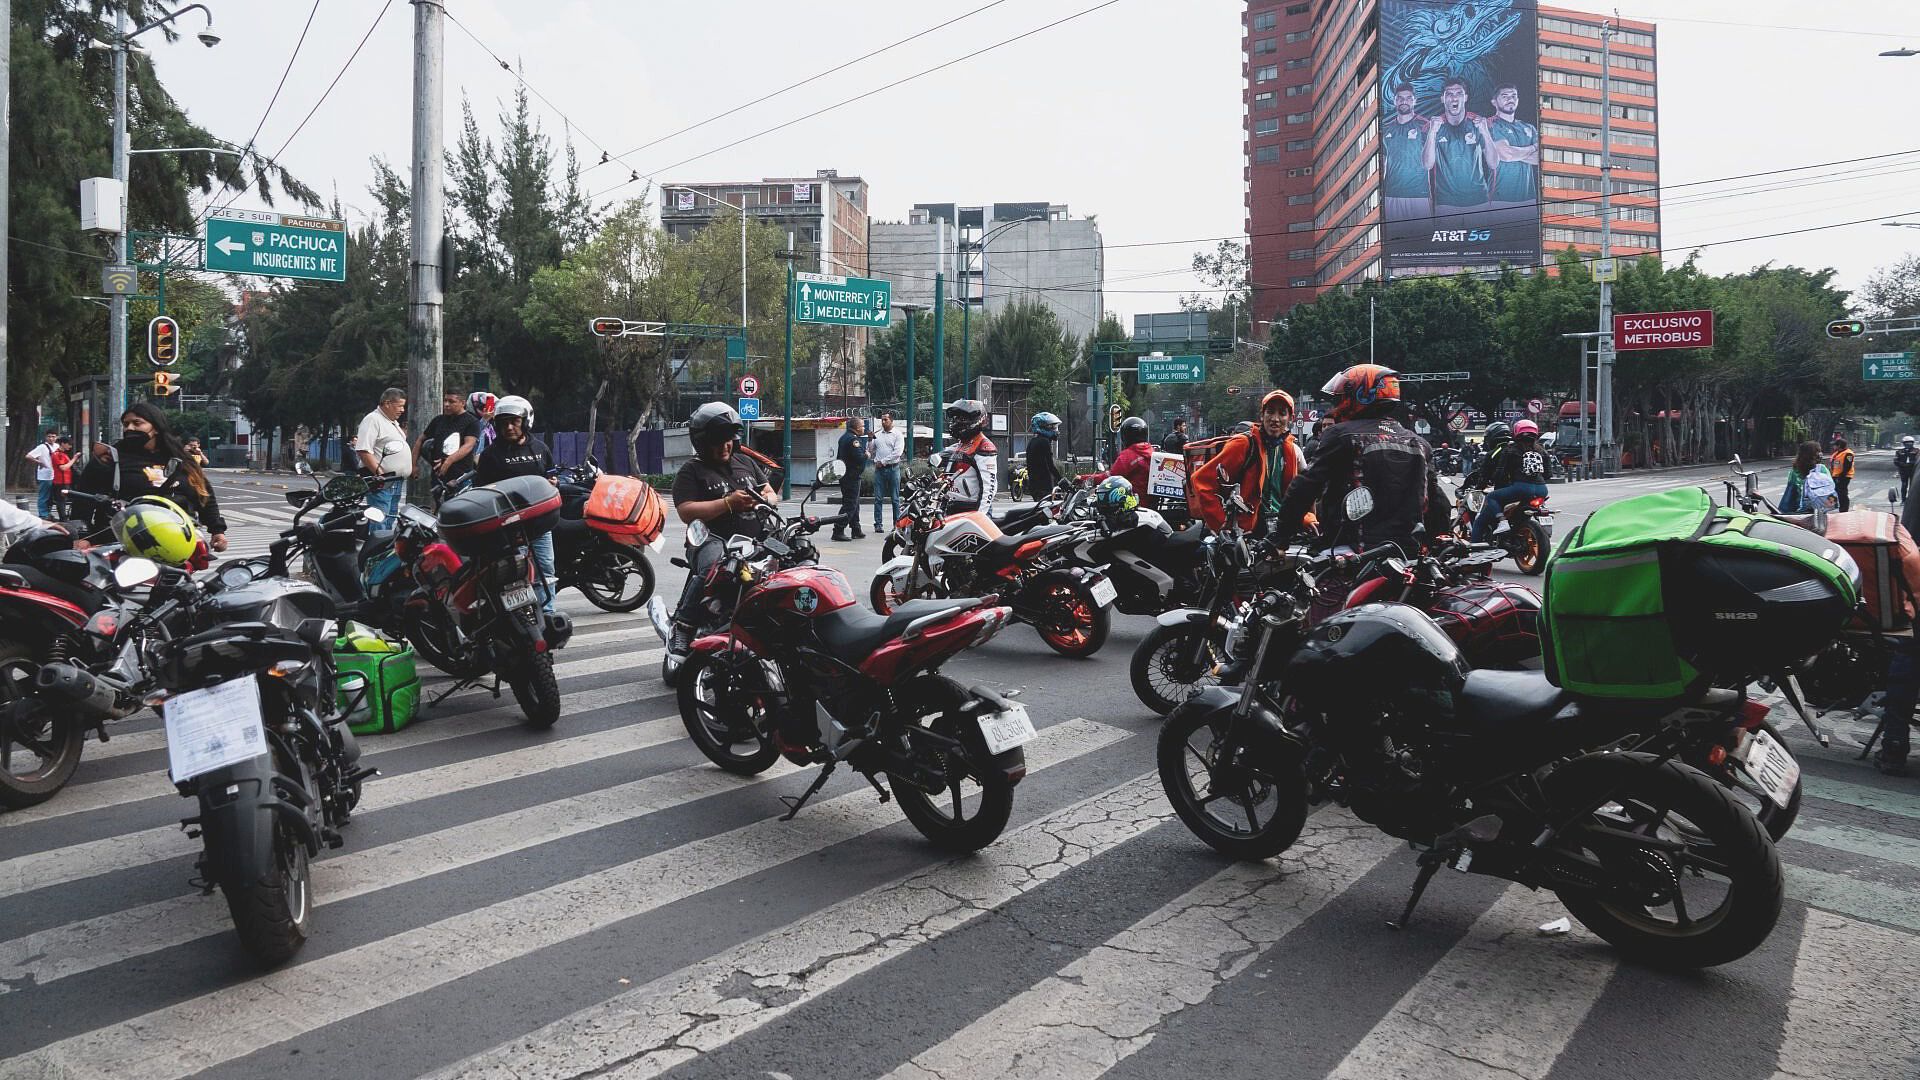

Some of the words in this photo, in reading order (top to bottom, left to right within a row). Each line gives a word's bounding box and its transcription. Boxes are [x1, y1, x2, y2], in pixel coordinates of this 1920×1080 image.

[212, 209, 231, 218] EJE
[252, 213, 272, 221] SUR
[287, 219, 327, 229] PACHUCA
[270, 232, 338, 253] PACHUCA
[1431, 230, 1467, 242] AT&T
[1468, 230, 1491, 241] 5G
[253, 251, 316, 271] INSURGENTES
[320, 258, 337, 273] NTE
[814, 288, 871, 304] MONTERREY
[876, 295, 884, 305] 2
[803, 305, 811, 316] 3
[817, 306, 872, 320] MEDELLIN
[1623, 316, 1702, 330] EXCLUSIVO
[1624, 331, 1702, 345] METROBUS
[1714, 612, 1759, 620] SH29
